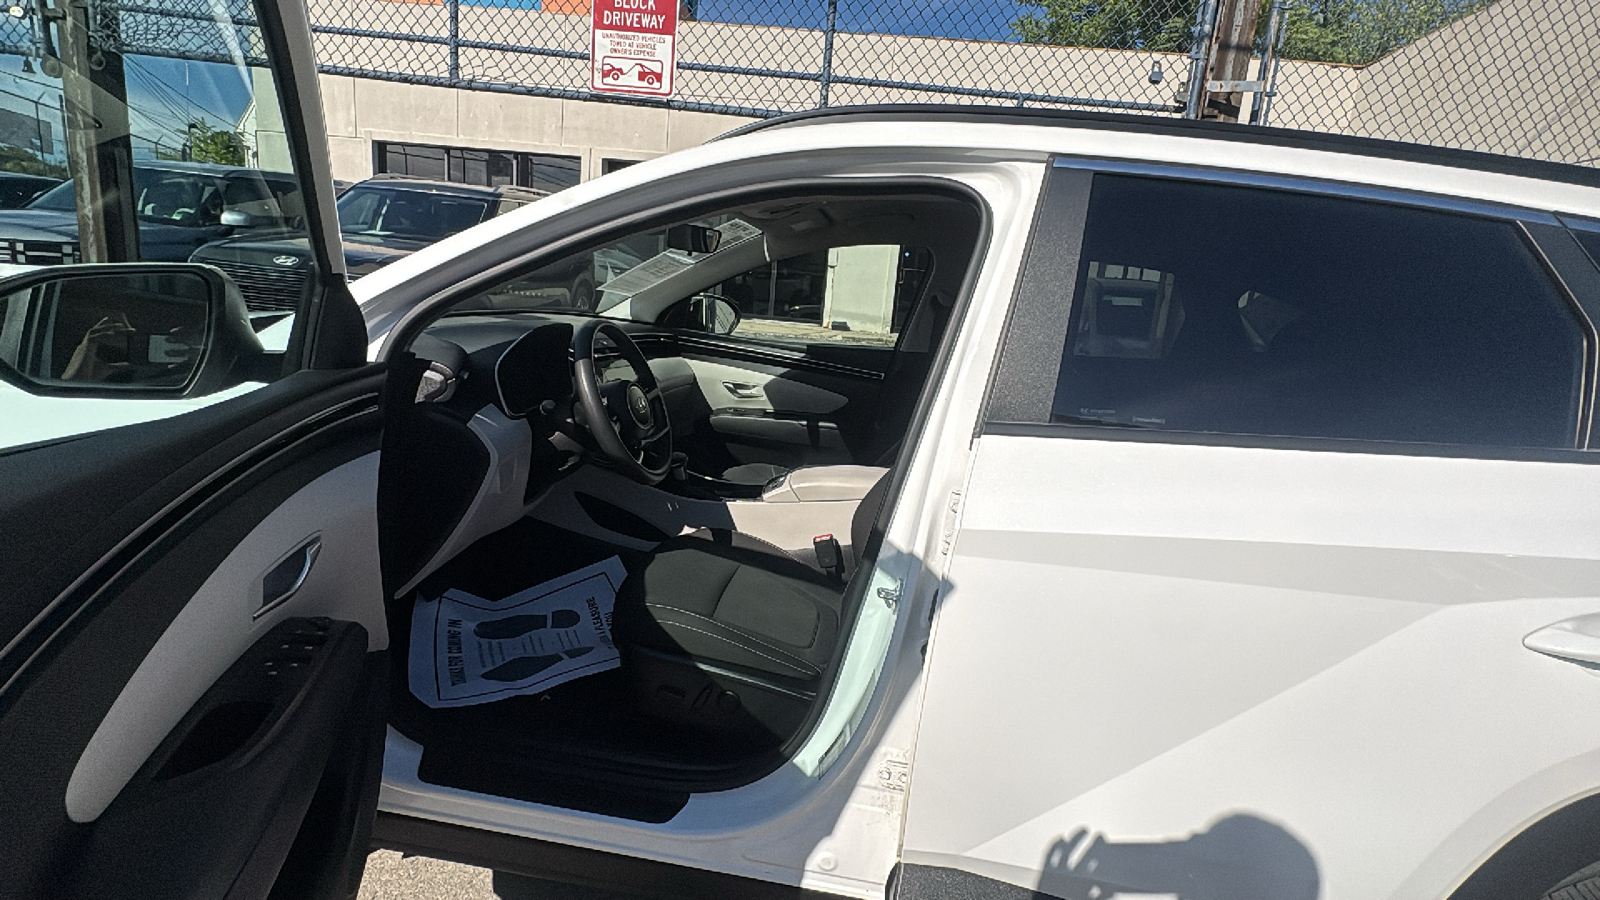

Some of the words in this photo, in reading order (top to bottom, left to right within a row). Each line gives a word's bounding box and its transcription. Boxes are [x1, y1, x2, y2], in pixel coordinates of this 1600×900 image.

[614, 0, 656, 11] BLOCK
[603, 10, 666, 29] DRIVEWAY
[601, 32, 640, 42] UNAUTHORIZED
[641, 35, 666, 44] VEHICLES
[636, 42, 657, 50] VEHICLE
[586, 596, 604, 631] PLEASURE
[448, 619, 463, 628] IN
[447, 630, 462, 654] COMING
